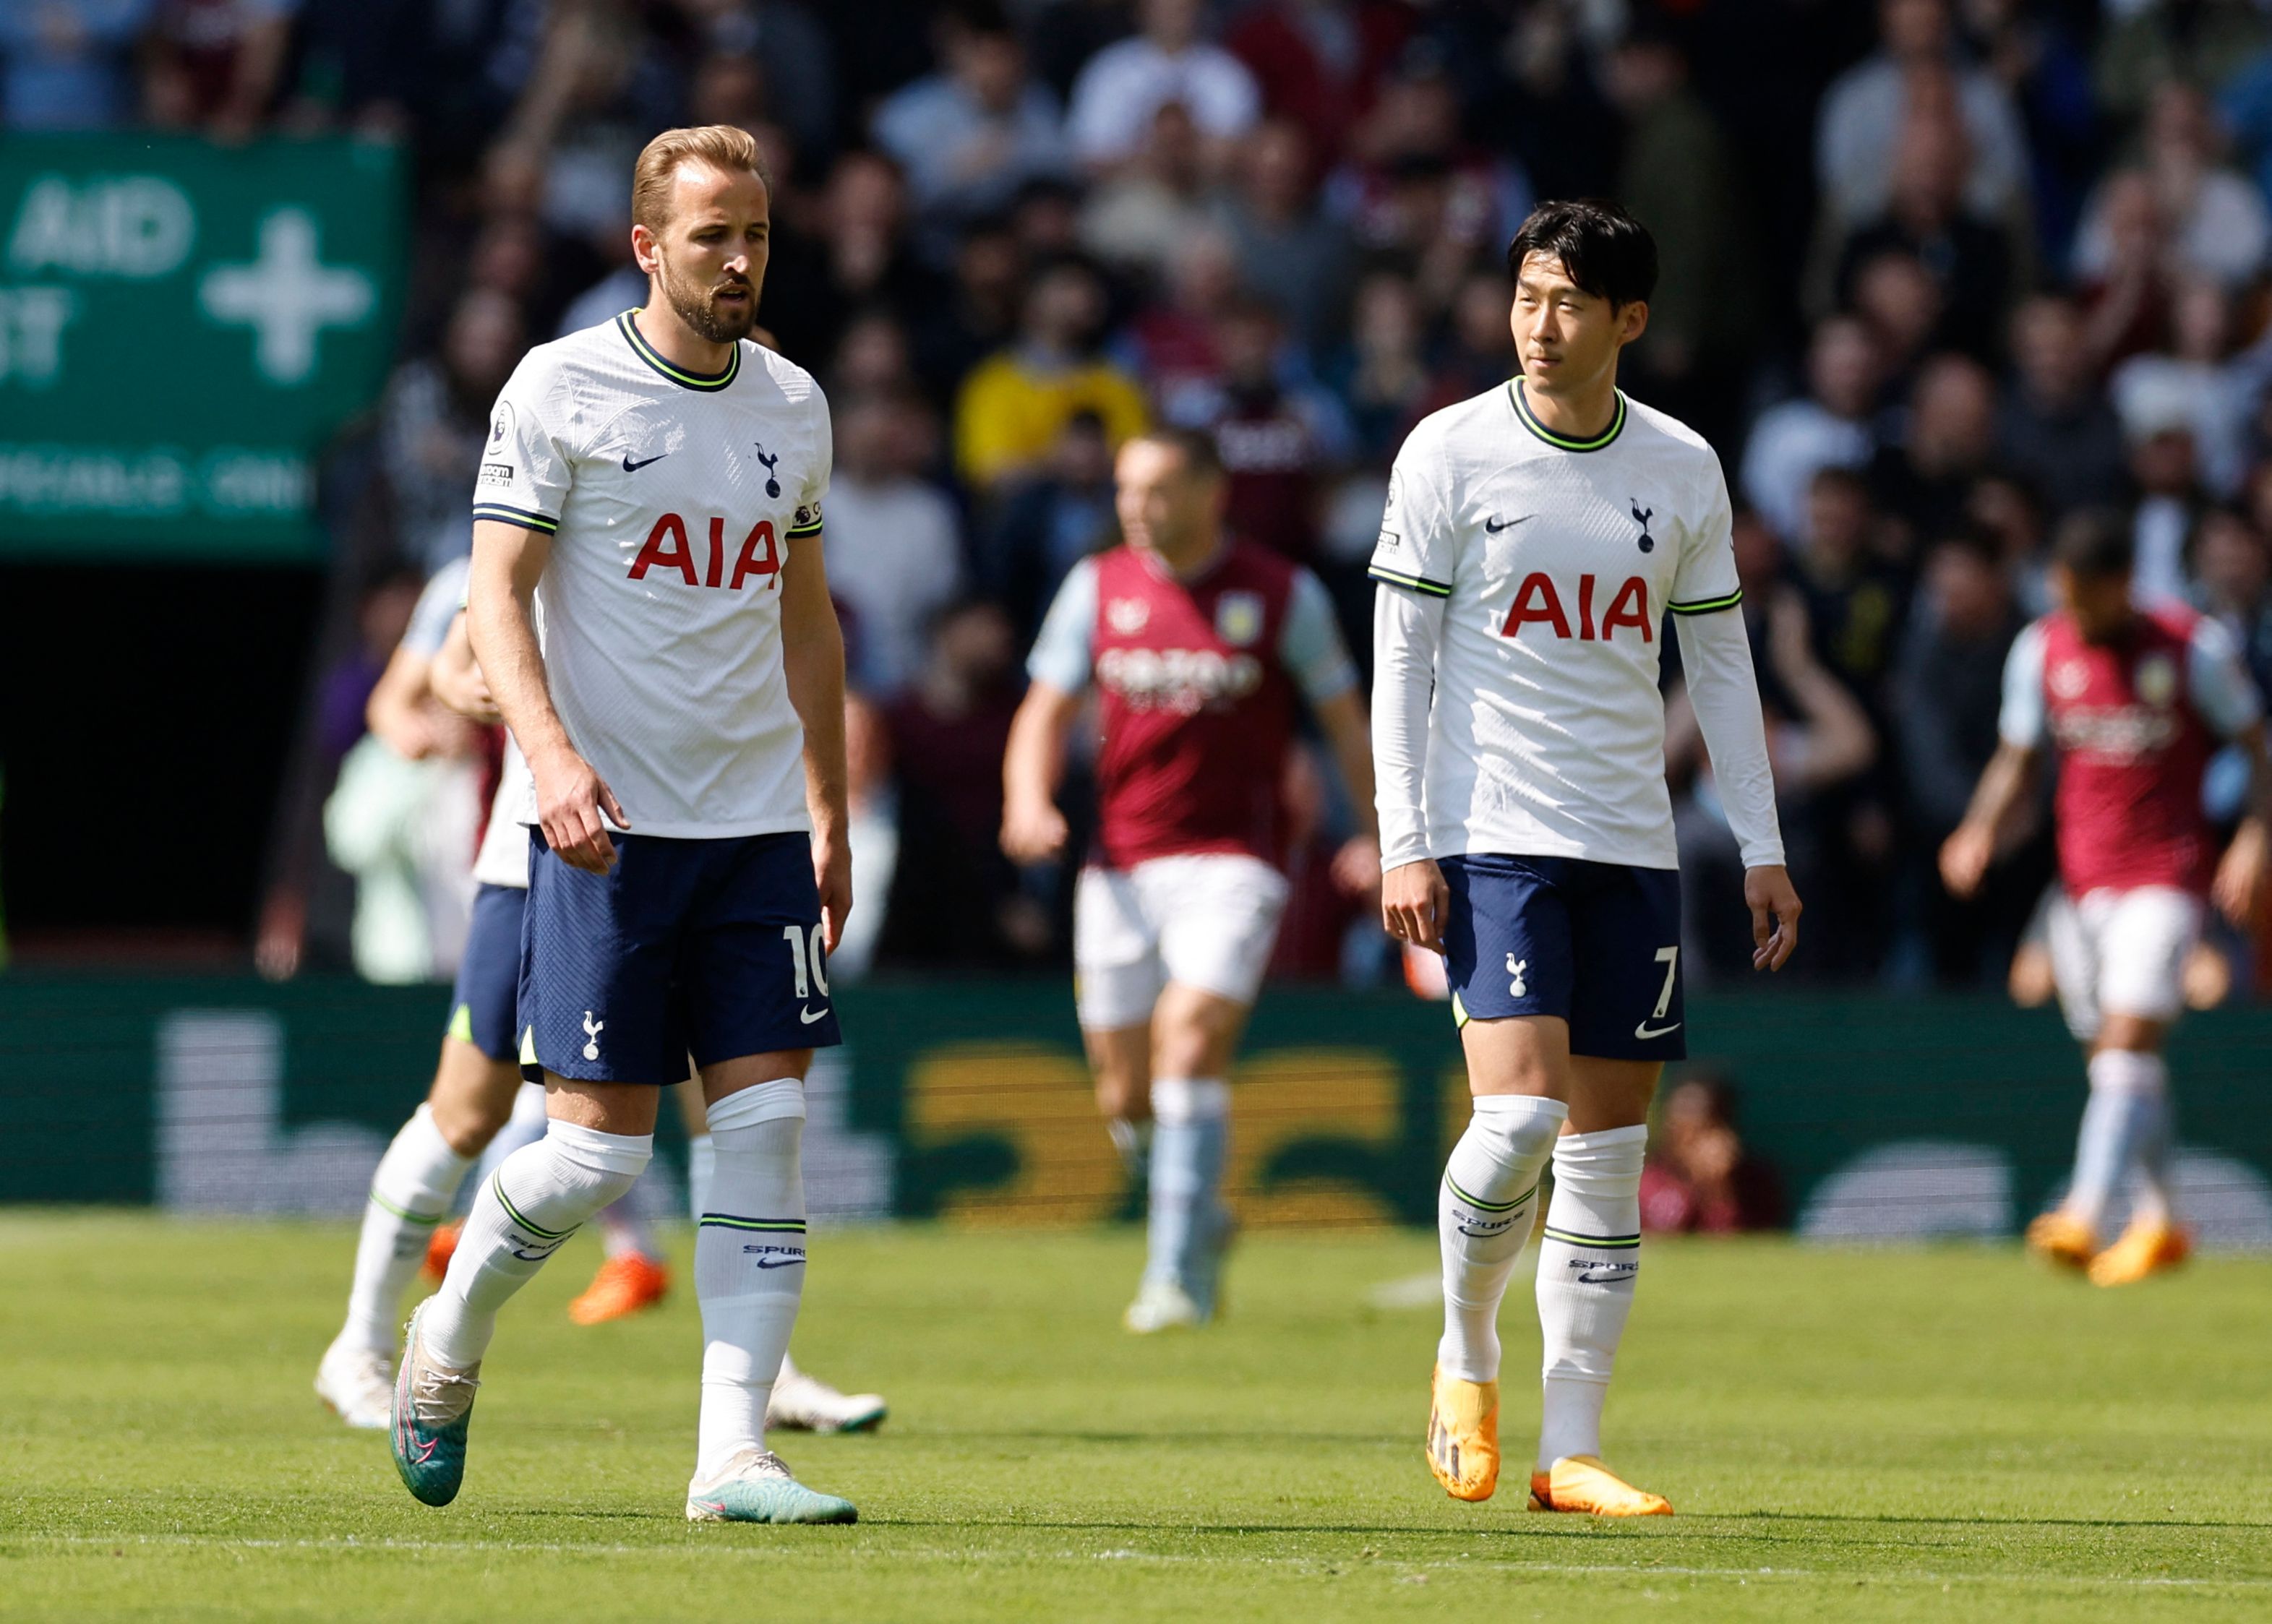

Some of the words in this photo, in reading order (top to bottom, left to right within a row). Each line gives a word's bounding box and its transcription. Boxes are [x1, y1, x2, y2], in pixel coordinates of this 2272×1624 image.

[9, 176, 195, 277] AID
[627, 512, 780, 590] AIA
[1501, 572, 1652, 643] AIA
[784, 923, 828, 998] 10
[1652, 946, 1678, 1018] 7
[1452, 1209, 1525, 1229] SPURS
